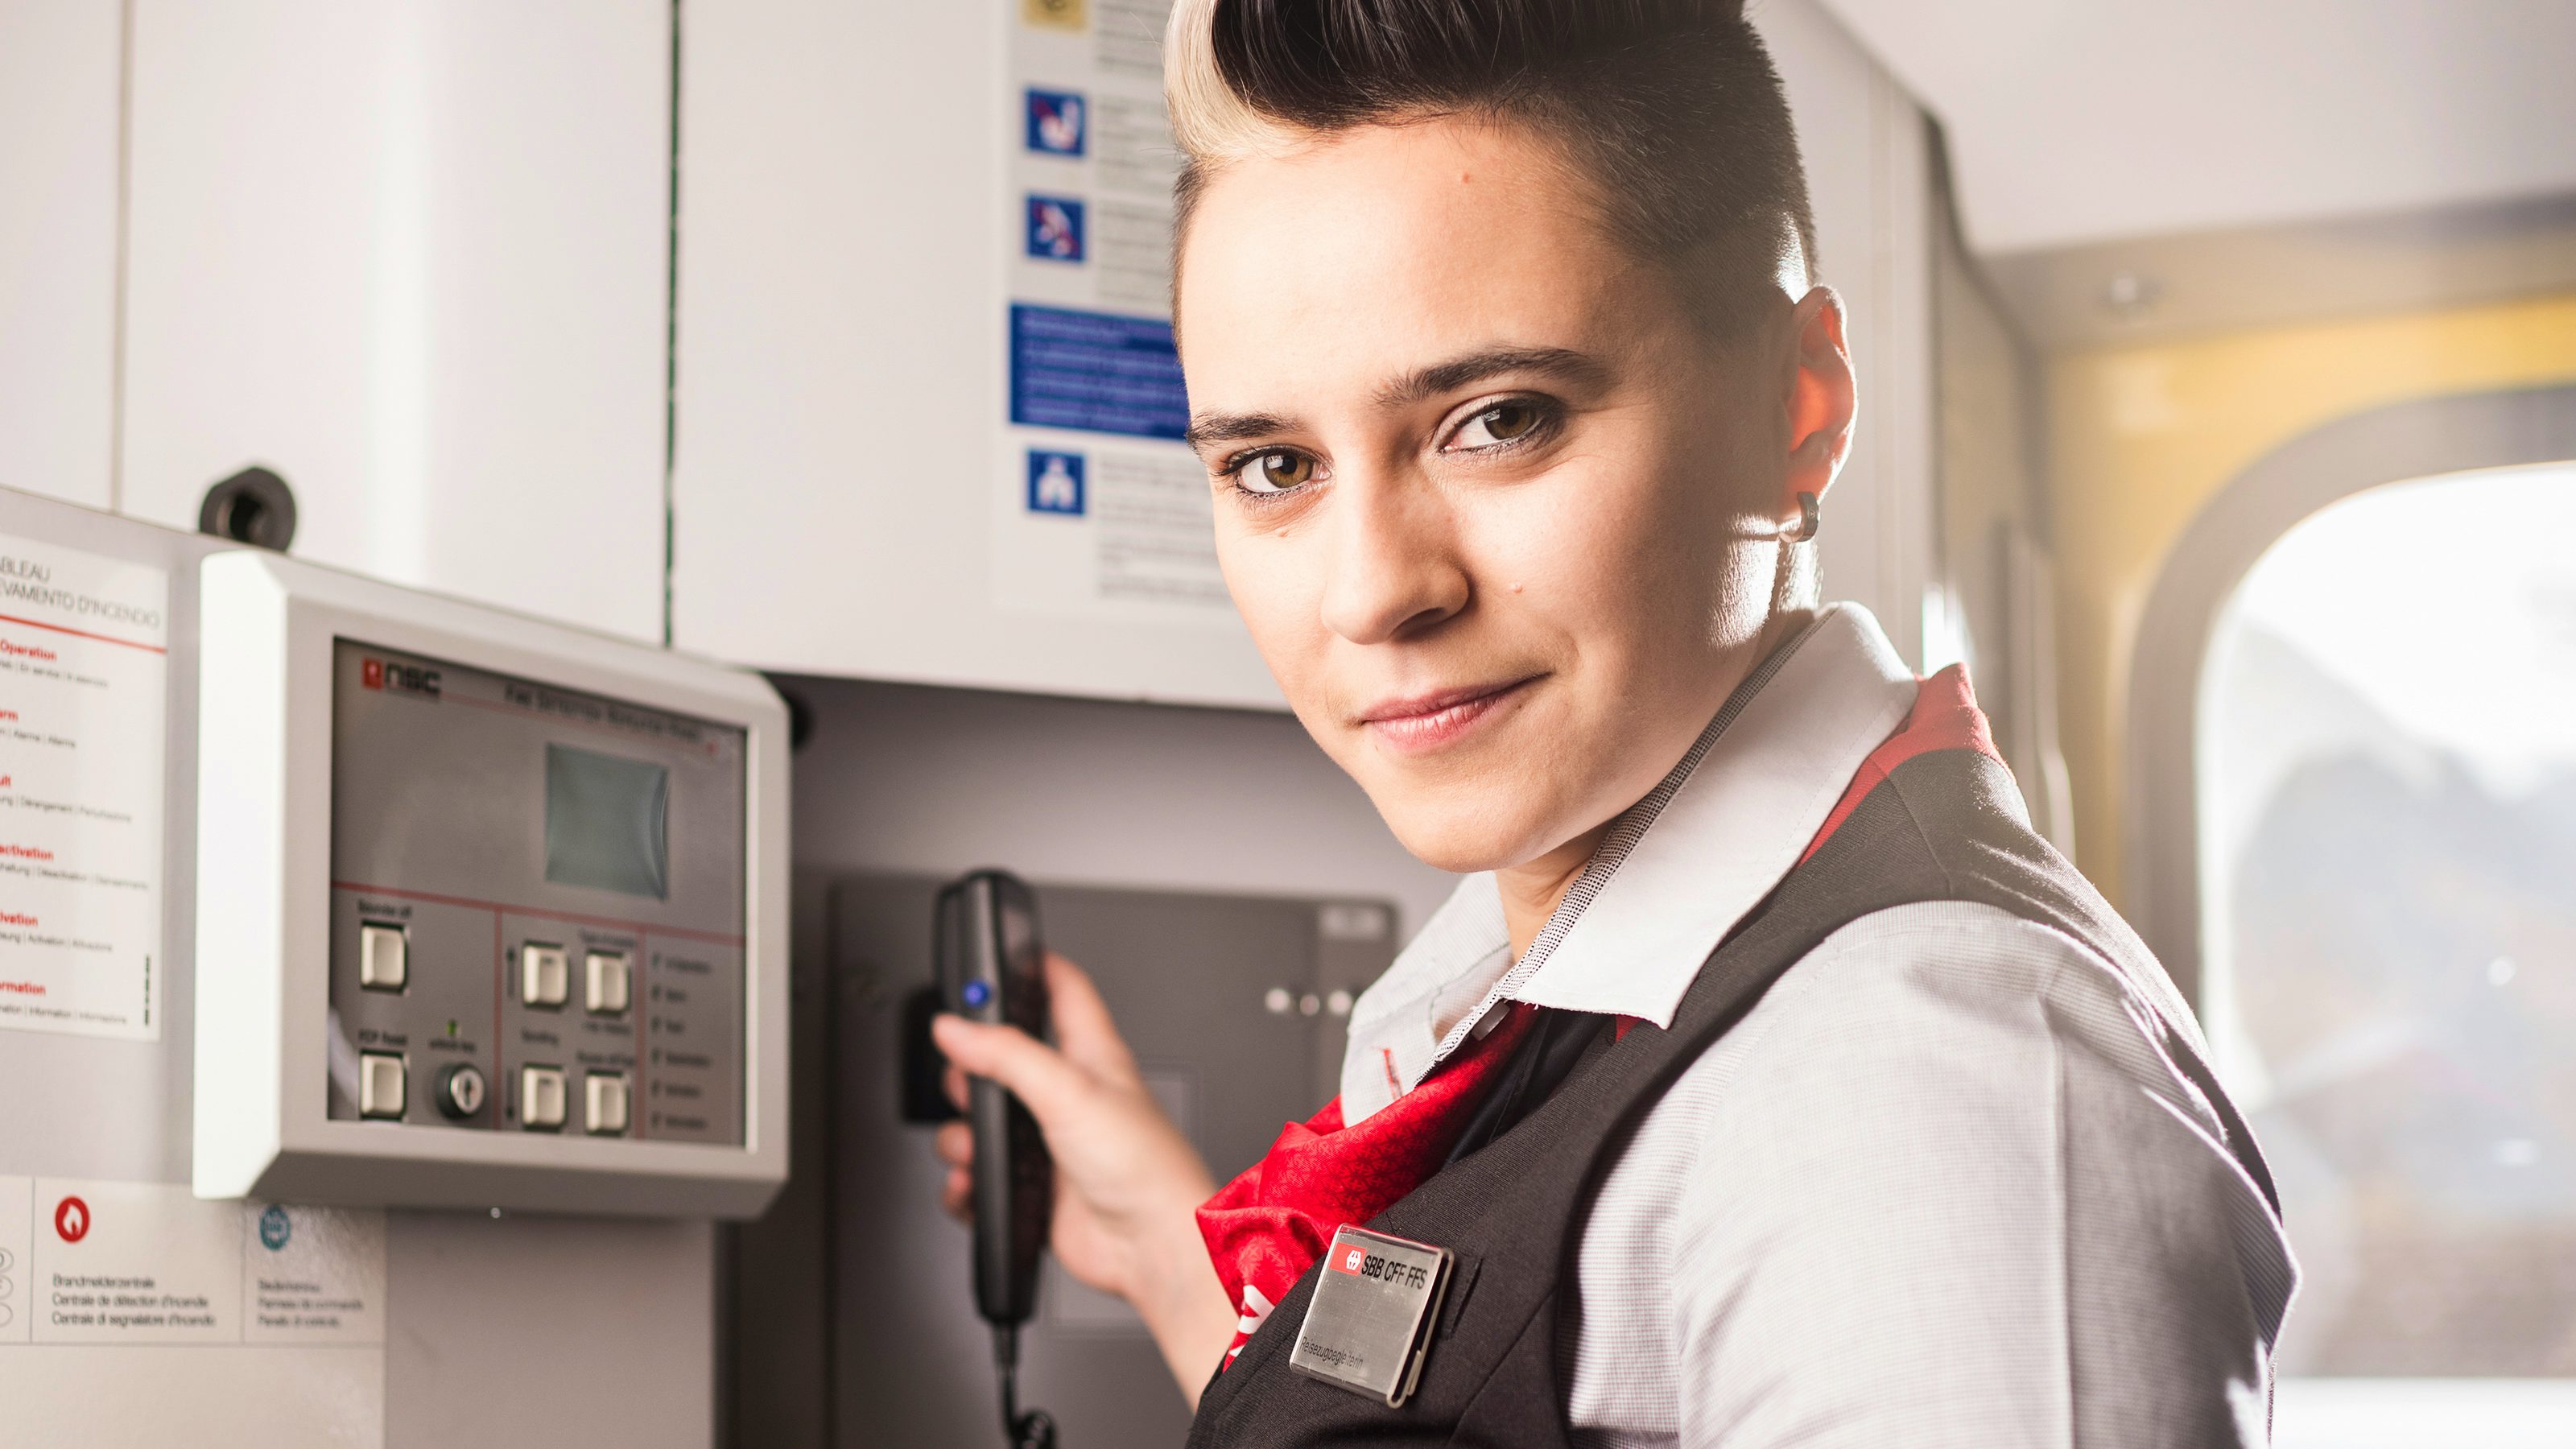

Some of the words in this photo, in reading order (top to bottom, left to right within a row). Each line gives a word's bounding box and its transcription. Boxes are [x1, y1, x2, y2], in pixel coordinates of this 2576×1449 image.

[0, 555, 51, 584] BLEAU
[0, 577, 75, 610] VAMENTO
[1, 639, 57, 662] Operation
[1361, 1254, 1385, 1278] SBB
[1385, 1261, 1407, 1284] CFF
[1405, 1265, 1428, 1290] FFS
[52, 1292, 94, 1307] Centrale
[52, 1311, 93, 1326] Centrale
[1302, 1336, 1364, 1370] Reisezugbegleiterin
